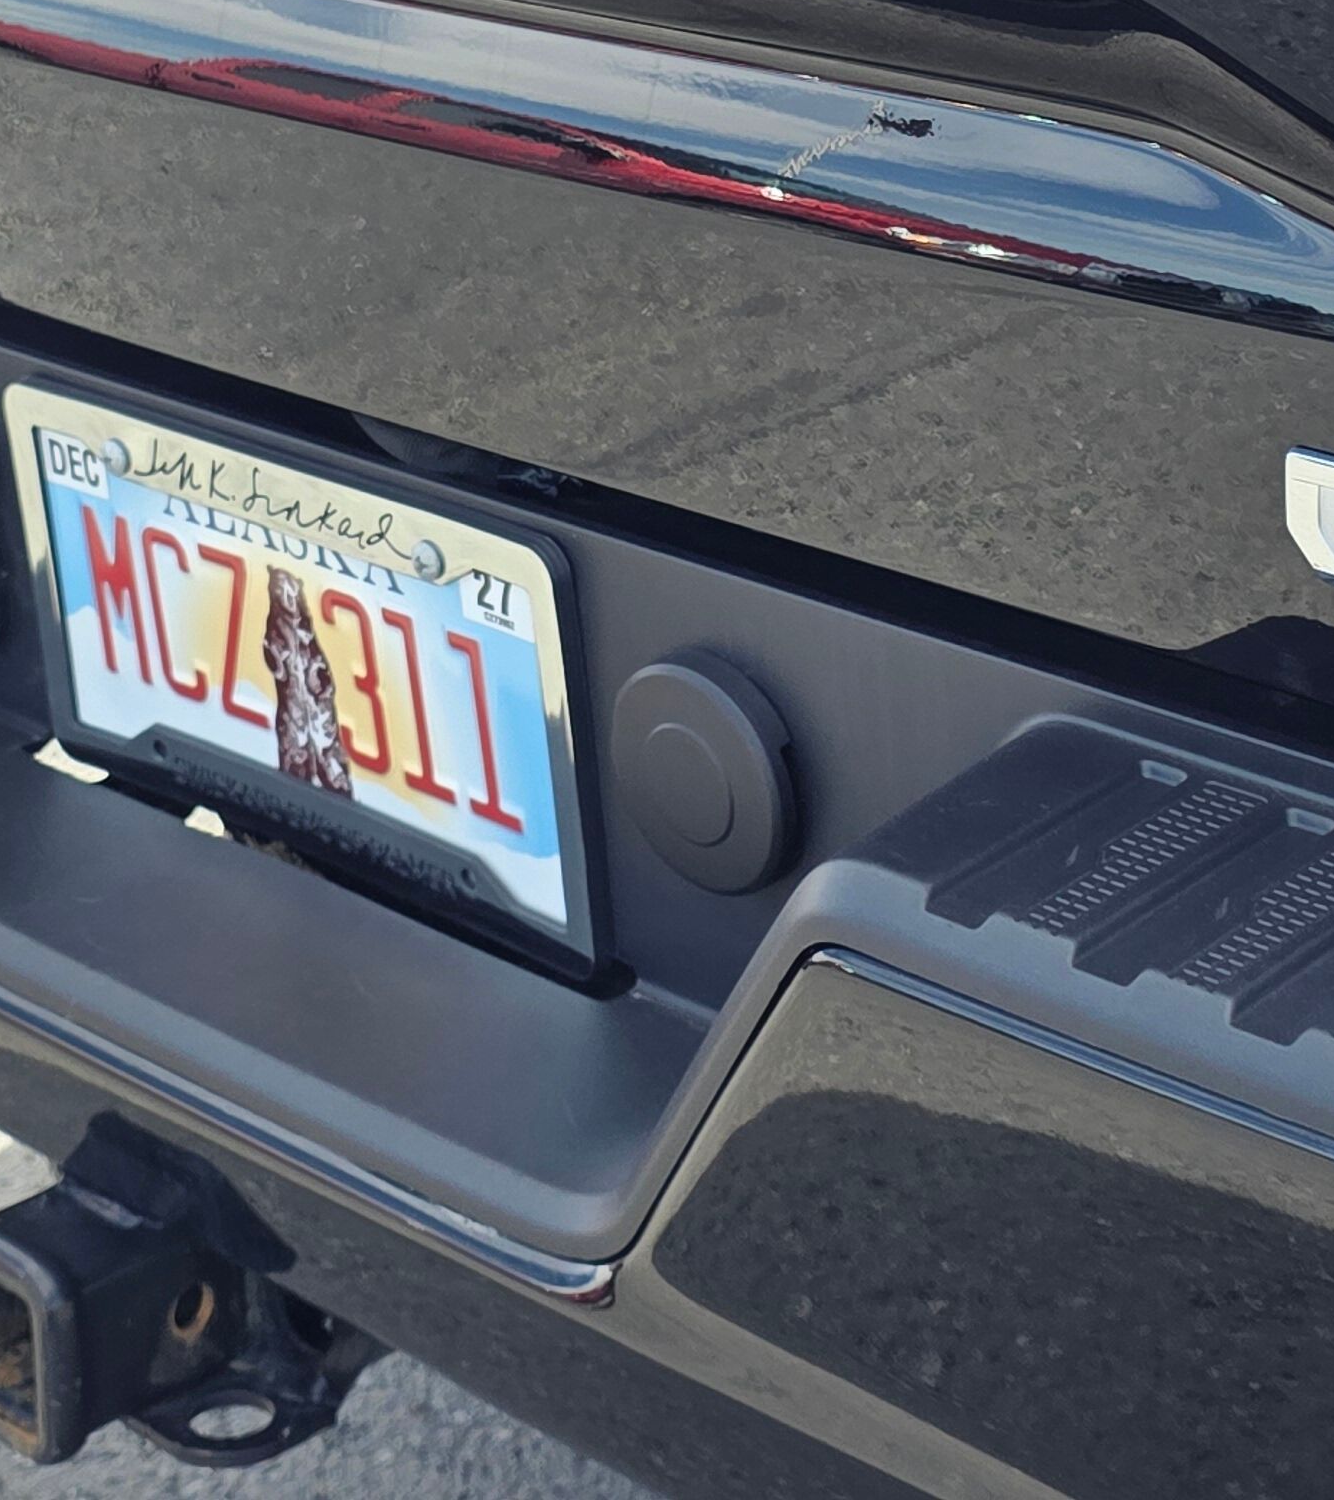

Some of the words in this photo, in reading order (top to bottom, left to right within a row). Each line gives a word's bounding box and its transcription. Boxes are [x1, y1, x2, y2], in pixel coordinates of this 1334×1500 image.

[47, 437, 101, 489] DEC
[471, 567, 512, 617] 27
[82, 504, 271, 730] MCZ
[320, 588, 524, 836] 311
